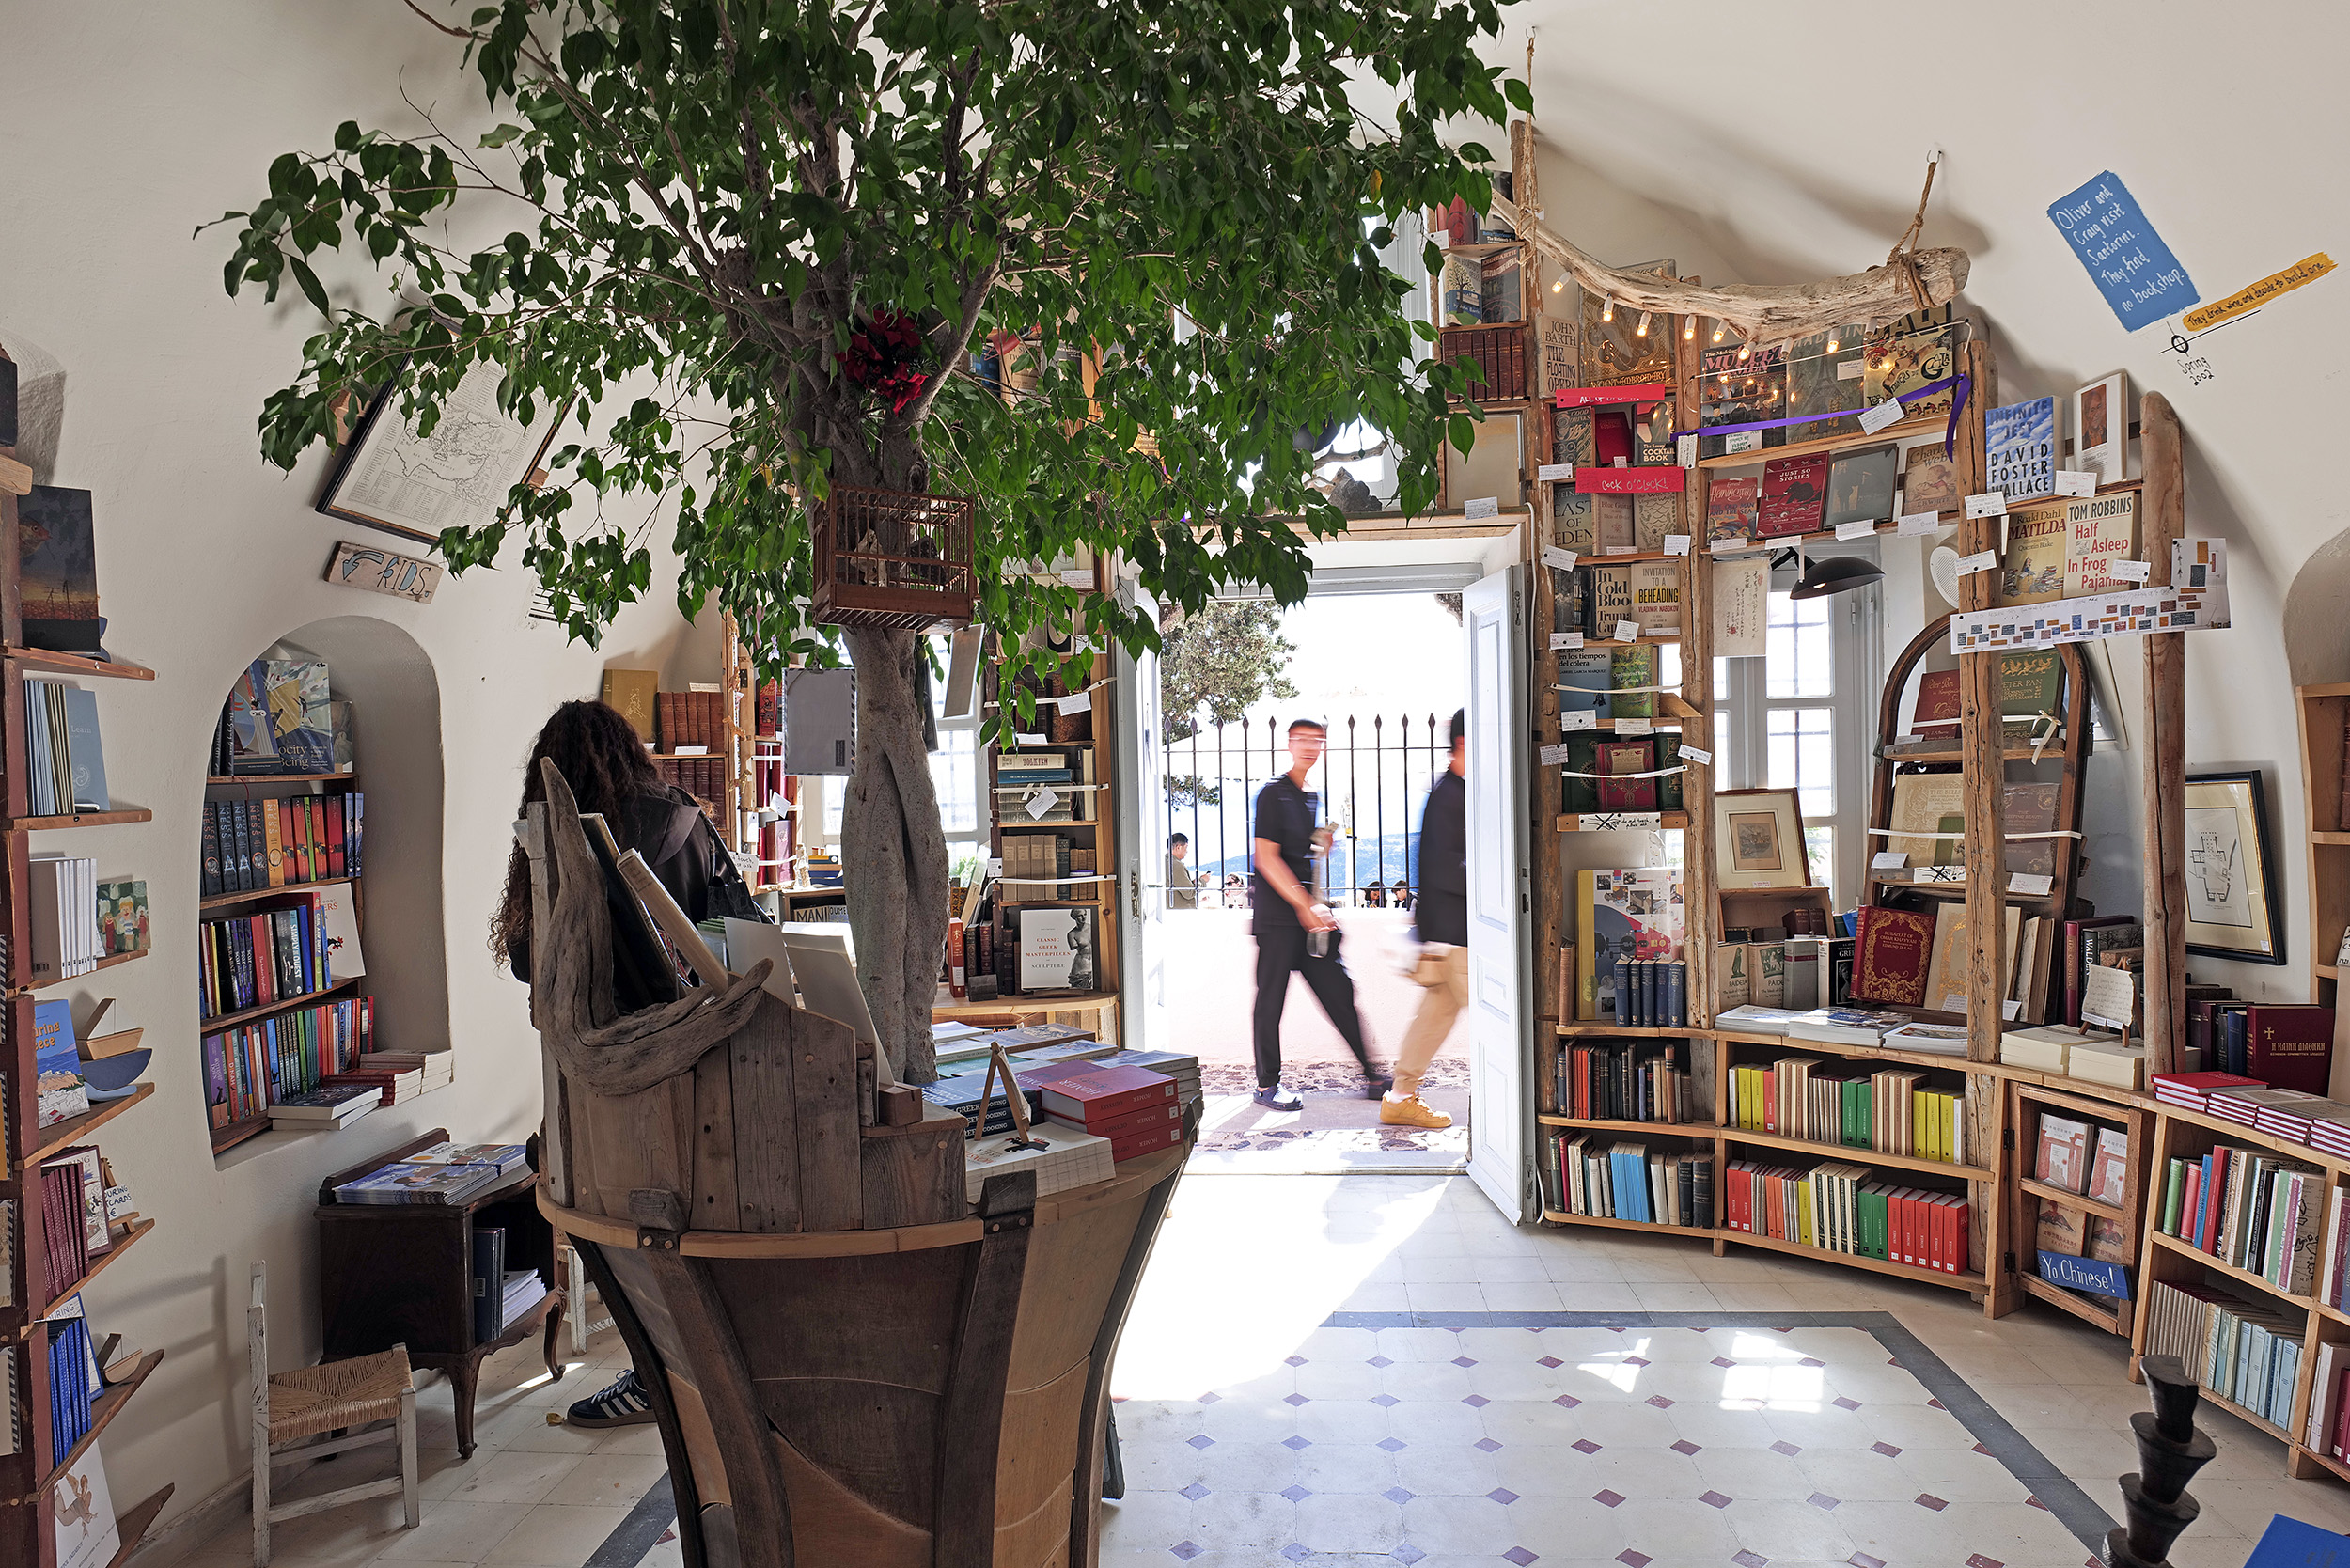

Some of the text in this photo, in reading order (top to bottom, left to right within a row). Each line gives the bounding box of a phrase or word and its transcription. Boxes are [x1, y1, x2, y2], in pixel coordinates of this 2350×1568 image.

[2055, 183, 2114, 229] Oliver and
[2073, 200, 2126, 246] Craig visit
[2087, 229, 2140, 266] Santorini.
[2100, 248, 2151, 291] They find
[2122, 298, 2134, 313] no
[2187, 310, 2206, 329] They
[2206, 304, 2226, 321] drink
[2225, 298, 2244, 312] wine
[2255, 280, 2278, 300] decide
[2284, 268, 2306, 287] build
[1551, 321, 1576, 334] JOHN
[1545, 331, 1577, 347] BARTH
[1546, 345, 1564, 362] THE
[1547, 361, 1575, 377] FLOATING
[2178, 355, 2212, 375] Spring
[1548, 376, 1575, 393] OPERA
[1619, 370, 1666, 385] EMBROIDERY
[2190, 369, 2215, 386] 2002
[1571, 408, 1589, 416] GOOD
[1990, 399, 2049, 423] INFINITE
[2004, 421, 2033, 440] JEST
[1990, 443, 2048, 468] DAVID
[1779, 474, 1810, 482] STORIES
[1991, 460, 2048, 483] FOSTER
[1710, 485, 1756, 502] Hemingway
[1991, 477, 2049, 498] WALLACE
[1554, 500, 1592, 517] EAST
[2017, 509, 2061, 525] Roald Dahl
[2068, 496, 2132, 523] TOM ROBBINS
[1566, 517, 1582, 528] OF
[2008, 518, 2067, 541] MATILDA
[2076, 522, 2099, 540] Half
[1555, 529, 1593, 545] EDEN
[2017, 541, 2054, 552] Quentin Blake
[2091, 538, 2129, 557] Asleep
[1642, 567, 1675, 576] INVITATION
[2067, 559, 2079, 573] In
[2081, 557, 2107, 575] Frog
[1598, 570, 1612, 583] In
[1652, 577, 1667, 586] TO A
[1598, 580, 1627, 595] Cold
[1638, 588, 1679, 604] BEHEADING
[1598, 594, 1632, 607] Bloo
[2002, 678, 2043, 688] ETER PAN
[70, 725, 92, 734] Learn
[278, 744, 306, 757] ocity
[1023, 758, 1048, 767] TOLKIEN
[219, 807, 227, 839] NESS
[234, 806, 243, 837] NESS
[249, 805, 258, 836] NESS
[267, 804, 275, 834] NESS
[795, 906, 828, 923] MANI
[290, 924, 299, 950] SIMPLY
[293, 955, 302, 979] QUEST
[34, 1022, 60, 1038] ring
[1058, 1079, 1103, 1096] HOMER
[956, 1103, 980, 1115] GREEK
[1100, 1092, 1152, 1110] HOMER ODYSSEY
[1104, 1114, 1156, 1133] HOMER ODYSSEY
[1138, 1137, 1158, 1147] HOMER
[2042, 1256, 2115, 1294] Yo Chinese!
